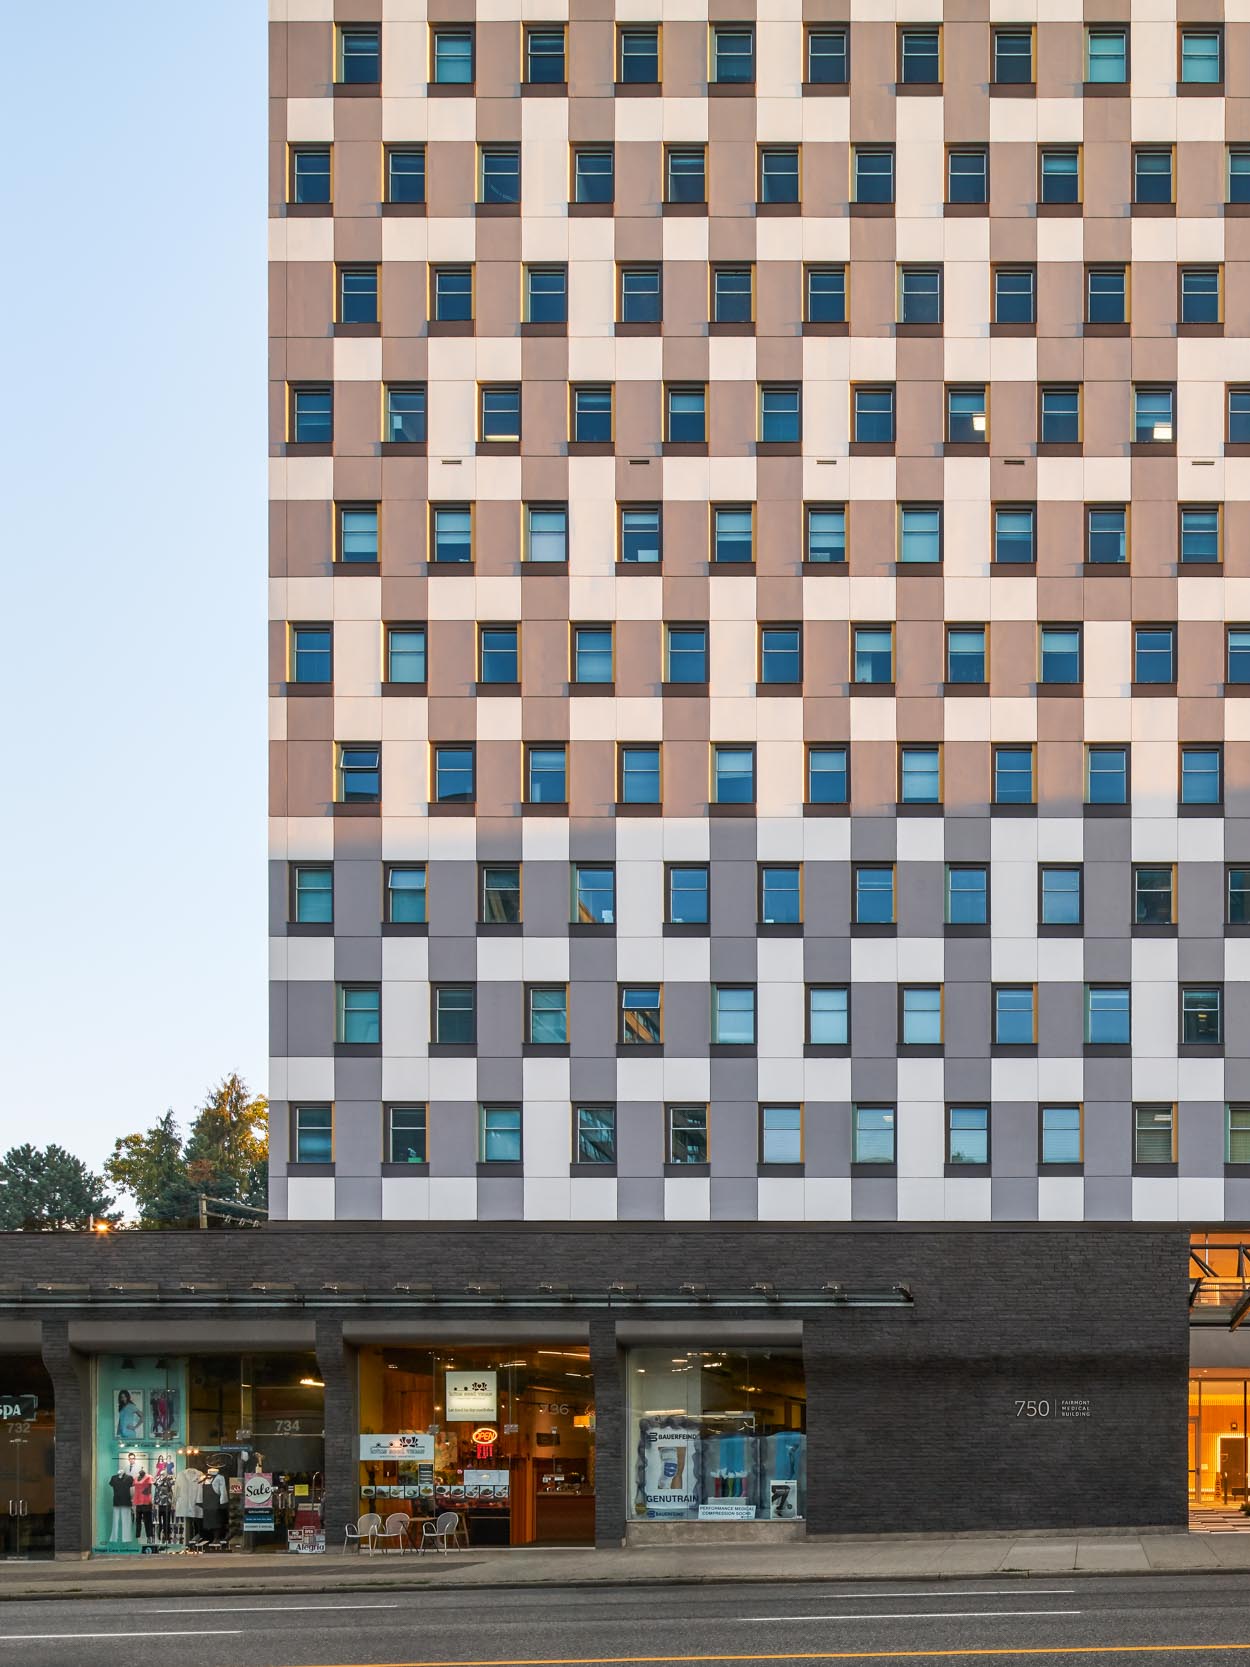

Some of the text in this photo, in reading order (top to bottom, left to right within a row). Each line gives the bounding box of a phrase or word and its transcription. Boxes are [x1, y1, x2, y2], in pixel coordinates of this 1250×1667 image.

[540, 1404, 569, 1415] 736
[1014, 1400, 1050, 1417] 750
[7, 1422, 31, 1434] 732
[274, 1419, 300, 1432] 734
[475, 1431, 495, 1441] OPEN
[245, 1483, 271, 1498] Sale
[646, 1494, 699, 1503] GENUTRAIN
[295, 1543, 325, 1552] Alegria
